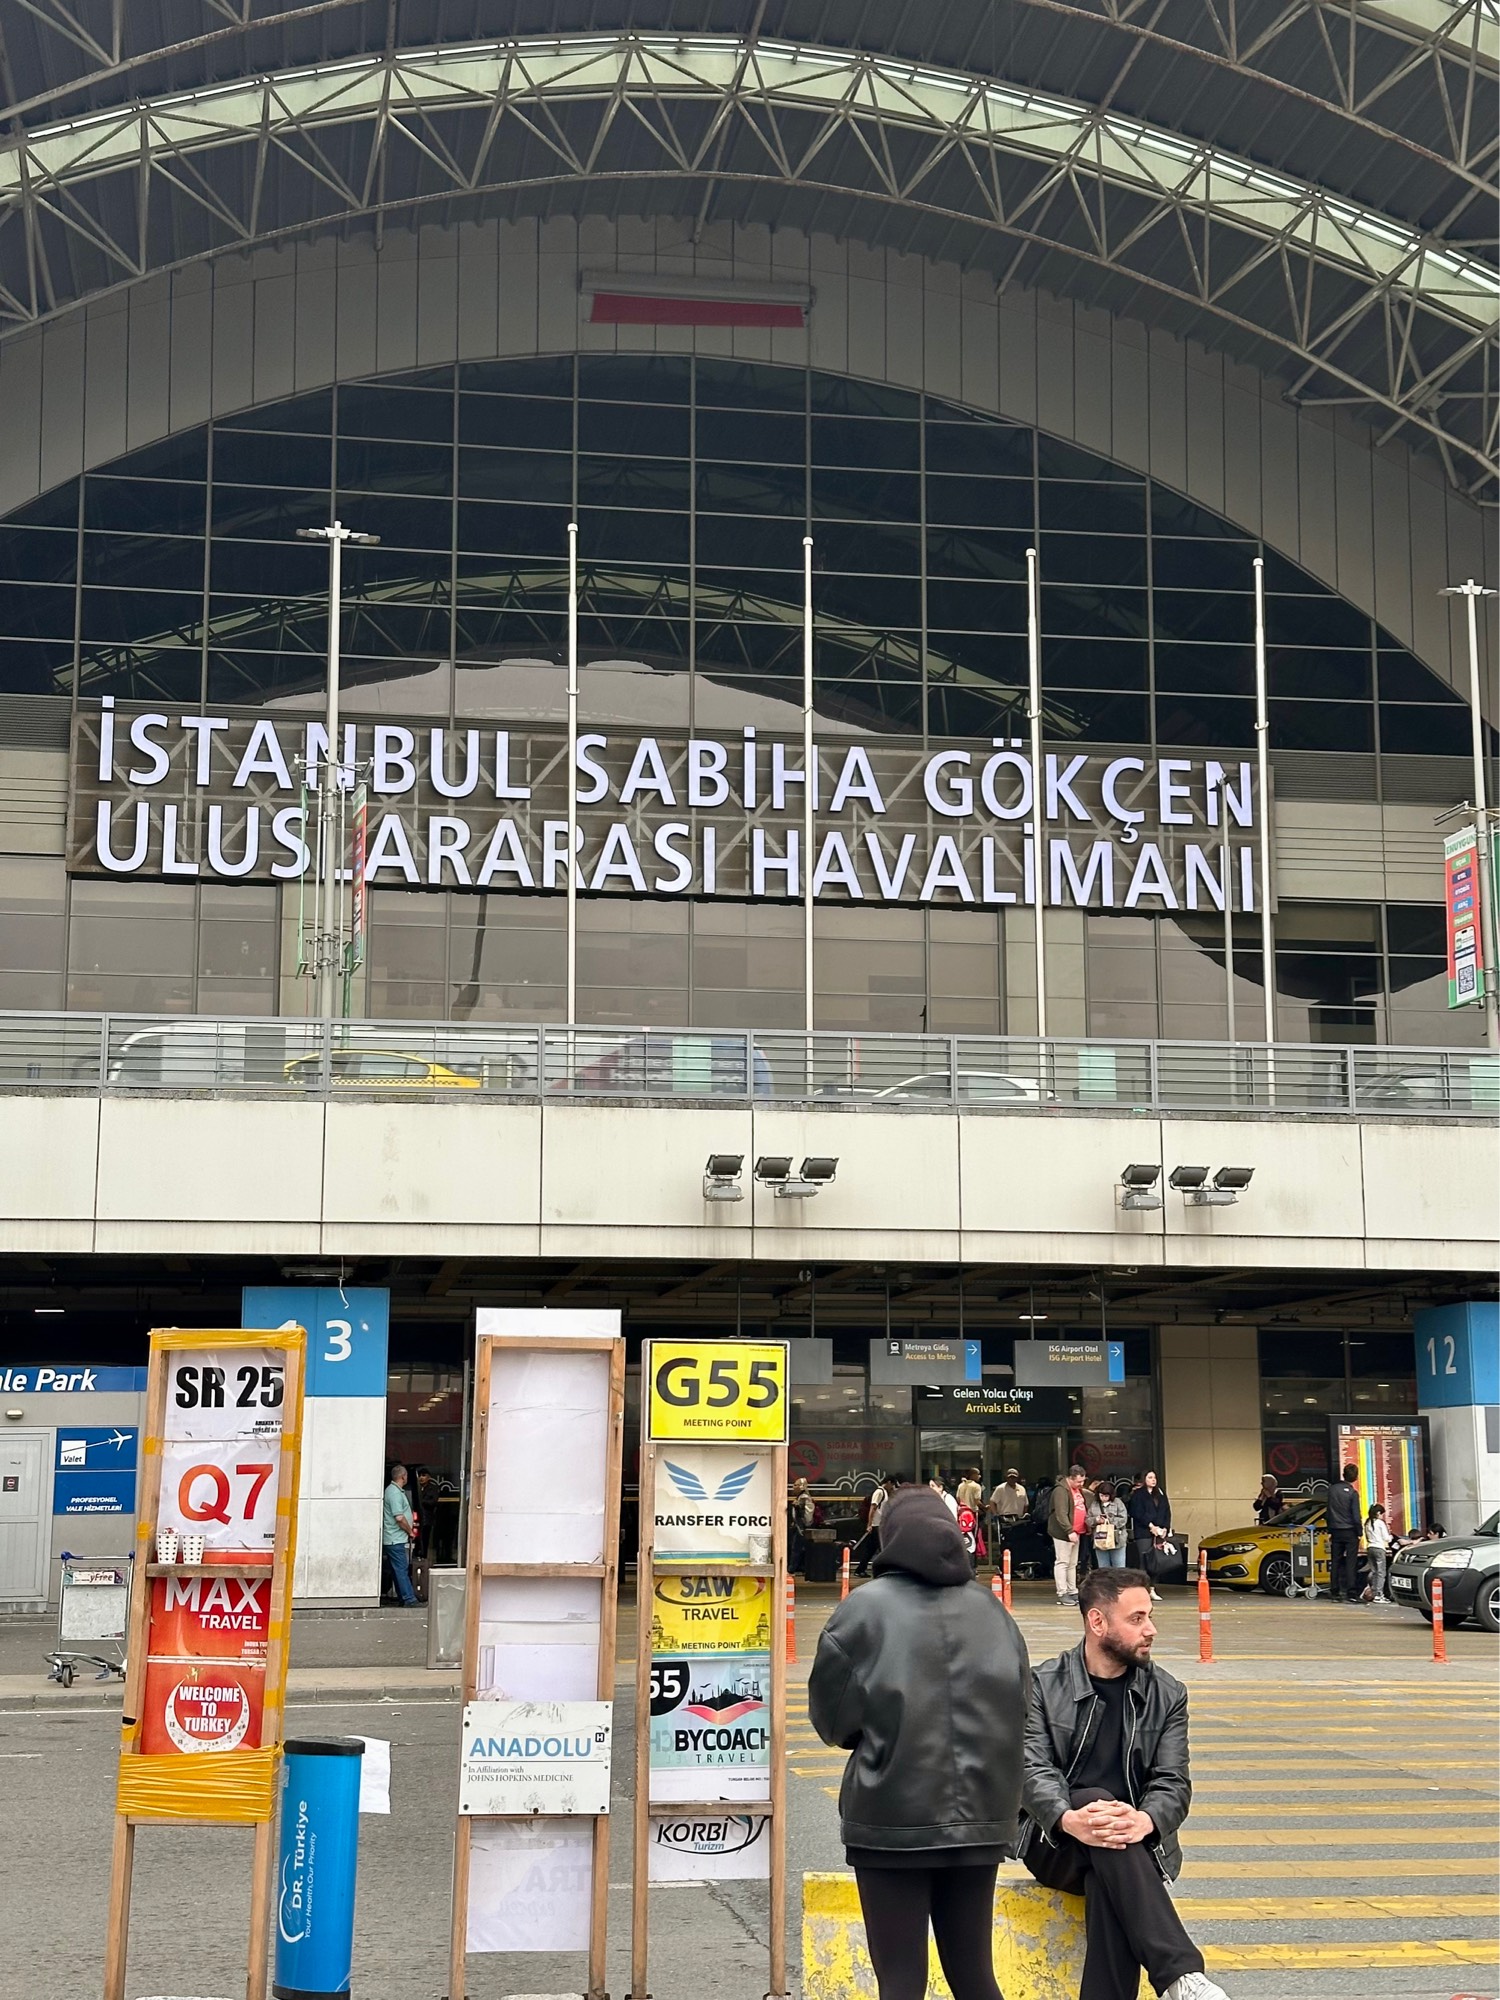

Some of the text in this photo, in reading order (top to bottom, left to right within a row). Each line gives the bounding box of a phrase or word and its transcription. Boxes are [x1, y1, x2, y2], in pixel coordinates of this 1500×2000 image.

[98, 695, 1253, 845] İSTANBUL SABİHA GÖKÇEN
[96, 800, 717, 895] ULUSLARARASI
[752, 822, 1255, 913] HAVALİMANI
[905, 1344, 949, 1352] Metroya Gidiş
[1060, 1345, 1084, 1354] Airport
[1427, 1335, 1457, 1375] 12
[1049, 1354, 1102, 1362] ISG Airport Hotel
[0, 1368, 98, 1392] le Park
[176, 1366, 284, 1409] SR 25
[656, 1357, 779, 1408] G55
[953, 1388, 1034, 1401] Gelen Yolcu Çıkışı
[966, 1403, 1021, 1413] Arrivals Exit
[684, 1418, 752, 1428] MEETING POINT
[178, 1464, 274, 1525] Q7
[680, 1576, 735, 1598] SAW
[164, 1578, 266, 1614] MAX
[199, 1614, 262, 1630] TRAVEL
[682, 1608, 739, 1621] TRAVEL
[681, 1642, 716, 1650] MEETING
[717, 1642, 740, 1650] POINT
[180, 1686, 240, 1702] WELCOME
[200, 1702, 217, 1717] TO
[184, 1716, 232, 1733] TURKEY
[470, 1738, 592, 1757] ANADOLU
[696, 1754, 756, 1764] TRAVEL
[468, 1774, 574, 1783] JOHNS HOPKINS MEDICINE
[658, 1818, 728, 1843] KORBİ
[694, 1841, 724, 1851] Turizm
[292, 1800, 309, 1909] DR. Türkiye
[304, 1919, 312, 1938] Your
[309, 1832, 317, 1865] Priority
